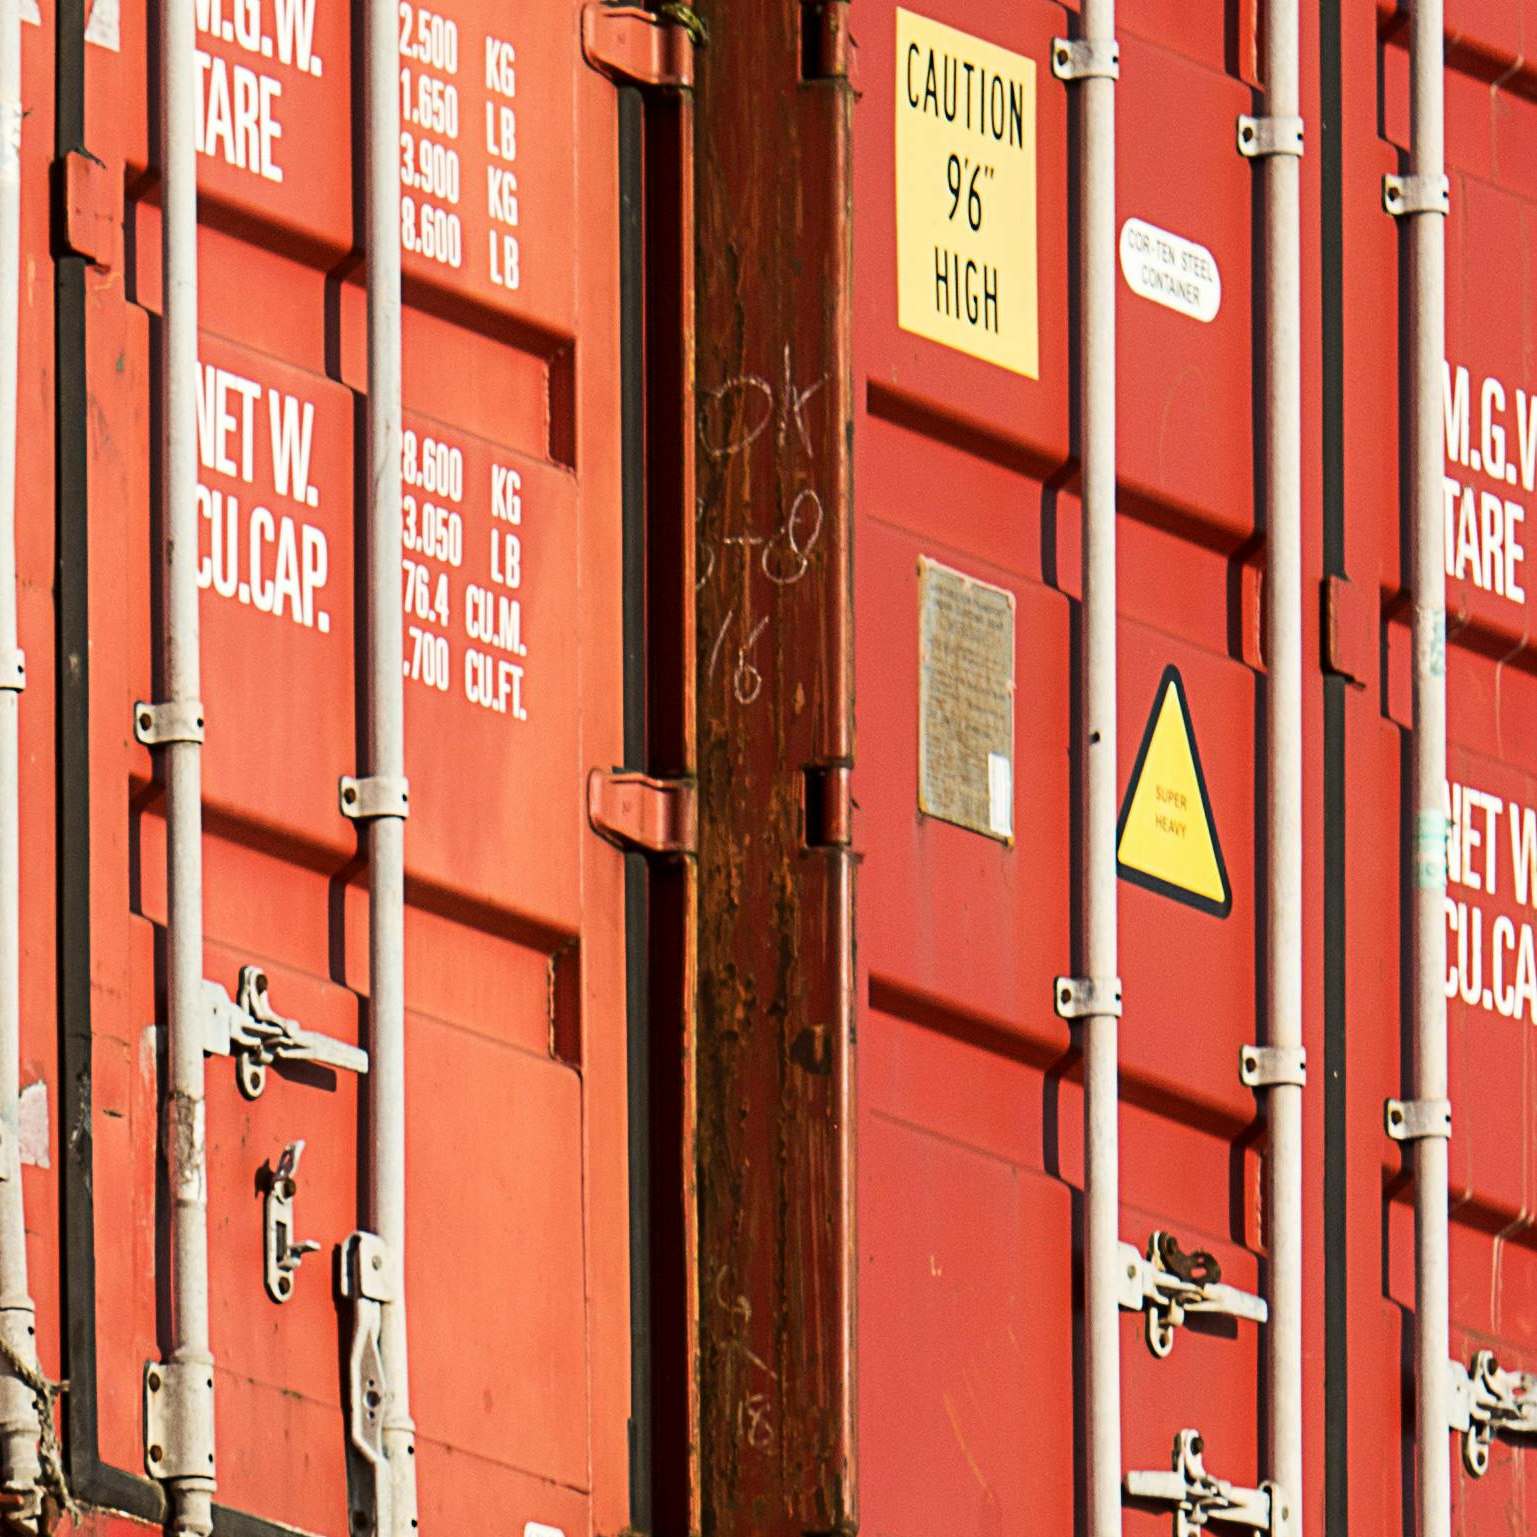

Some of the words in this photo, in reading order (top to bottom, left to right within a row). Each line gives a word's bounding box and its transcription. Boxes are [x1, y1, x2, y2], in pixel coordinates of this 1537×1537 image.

[485, 36, 516, 98] KG
[906, 42, 1024, 150] CAUTION
[195, 50, 283, 183] TARE
[486, 101, 517, 162] LB
[487, 165, 519, 227] KG
[489, 229, 520, 290] LB
[1127, 228, 1177, 266] COR-TEN
[1181, 250, 1214, 284] STEEL
[1141, 267, 1201, 307] CONTAINER
[933, 245, 1000, 335] HIGH
[195, 362, 261, 485] NET
[268, 387, 320, 507] W.
[491, 463, 522, 526] KG
[195, 484, 330, 634] CU.CAP.
[490, 527, 522, 590] LB
[1443, 475, 1525, 605] TARE
[465, 584, 528, 657] CU.M.
[463, 648, 528, 722] CU.FT.
[1154, 785, 1188, 812] SUPER
[1154, 813, 1187, 839] HEAVY
[1444, 778, 1504, 895] NET
